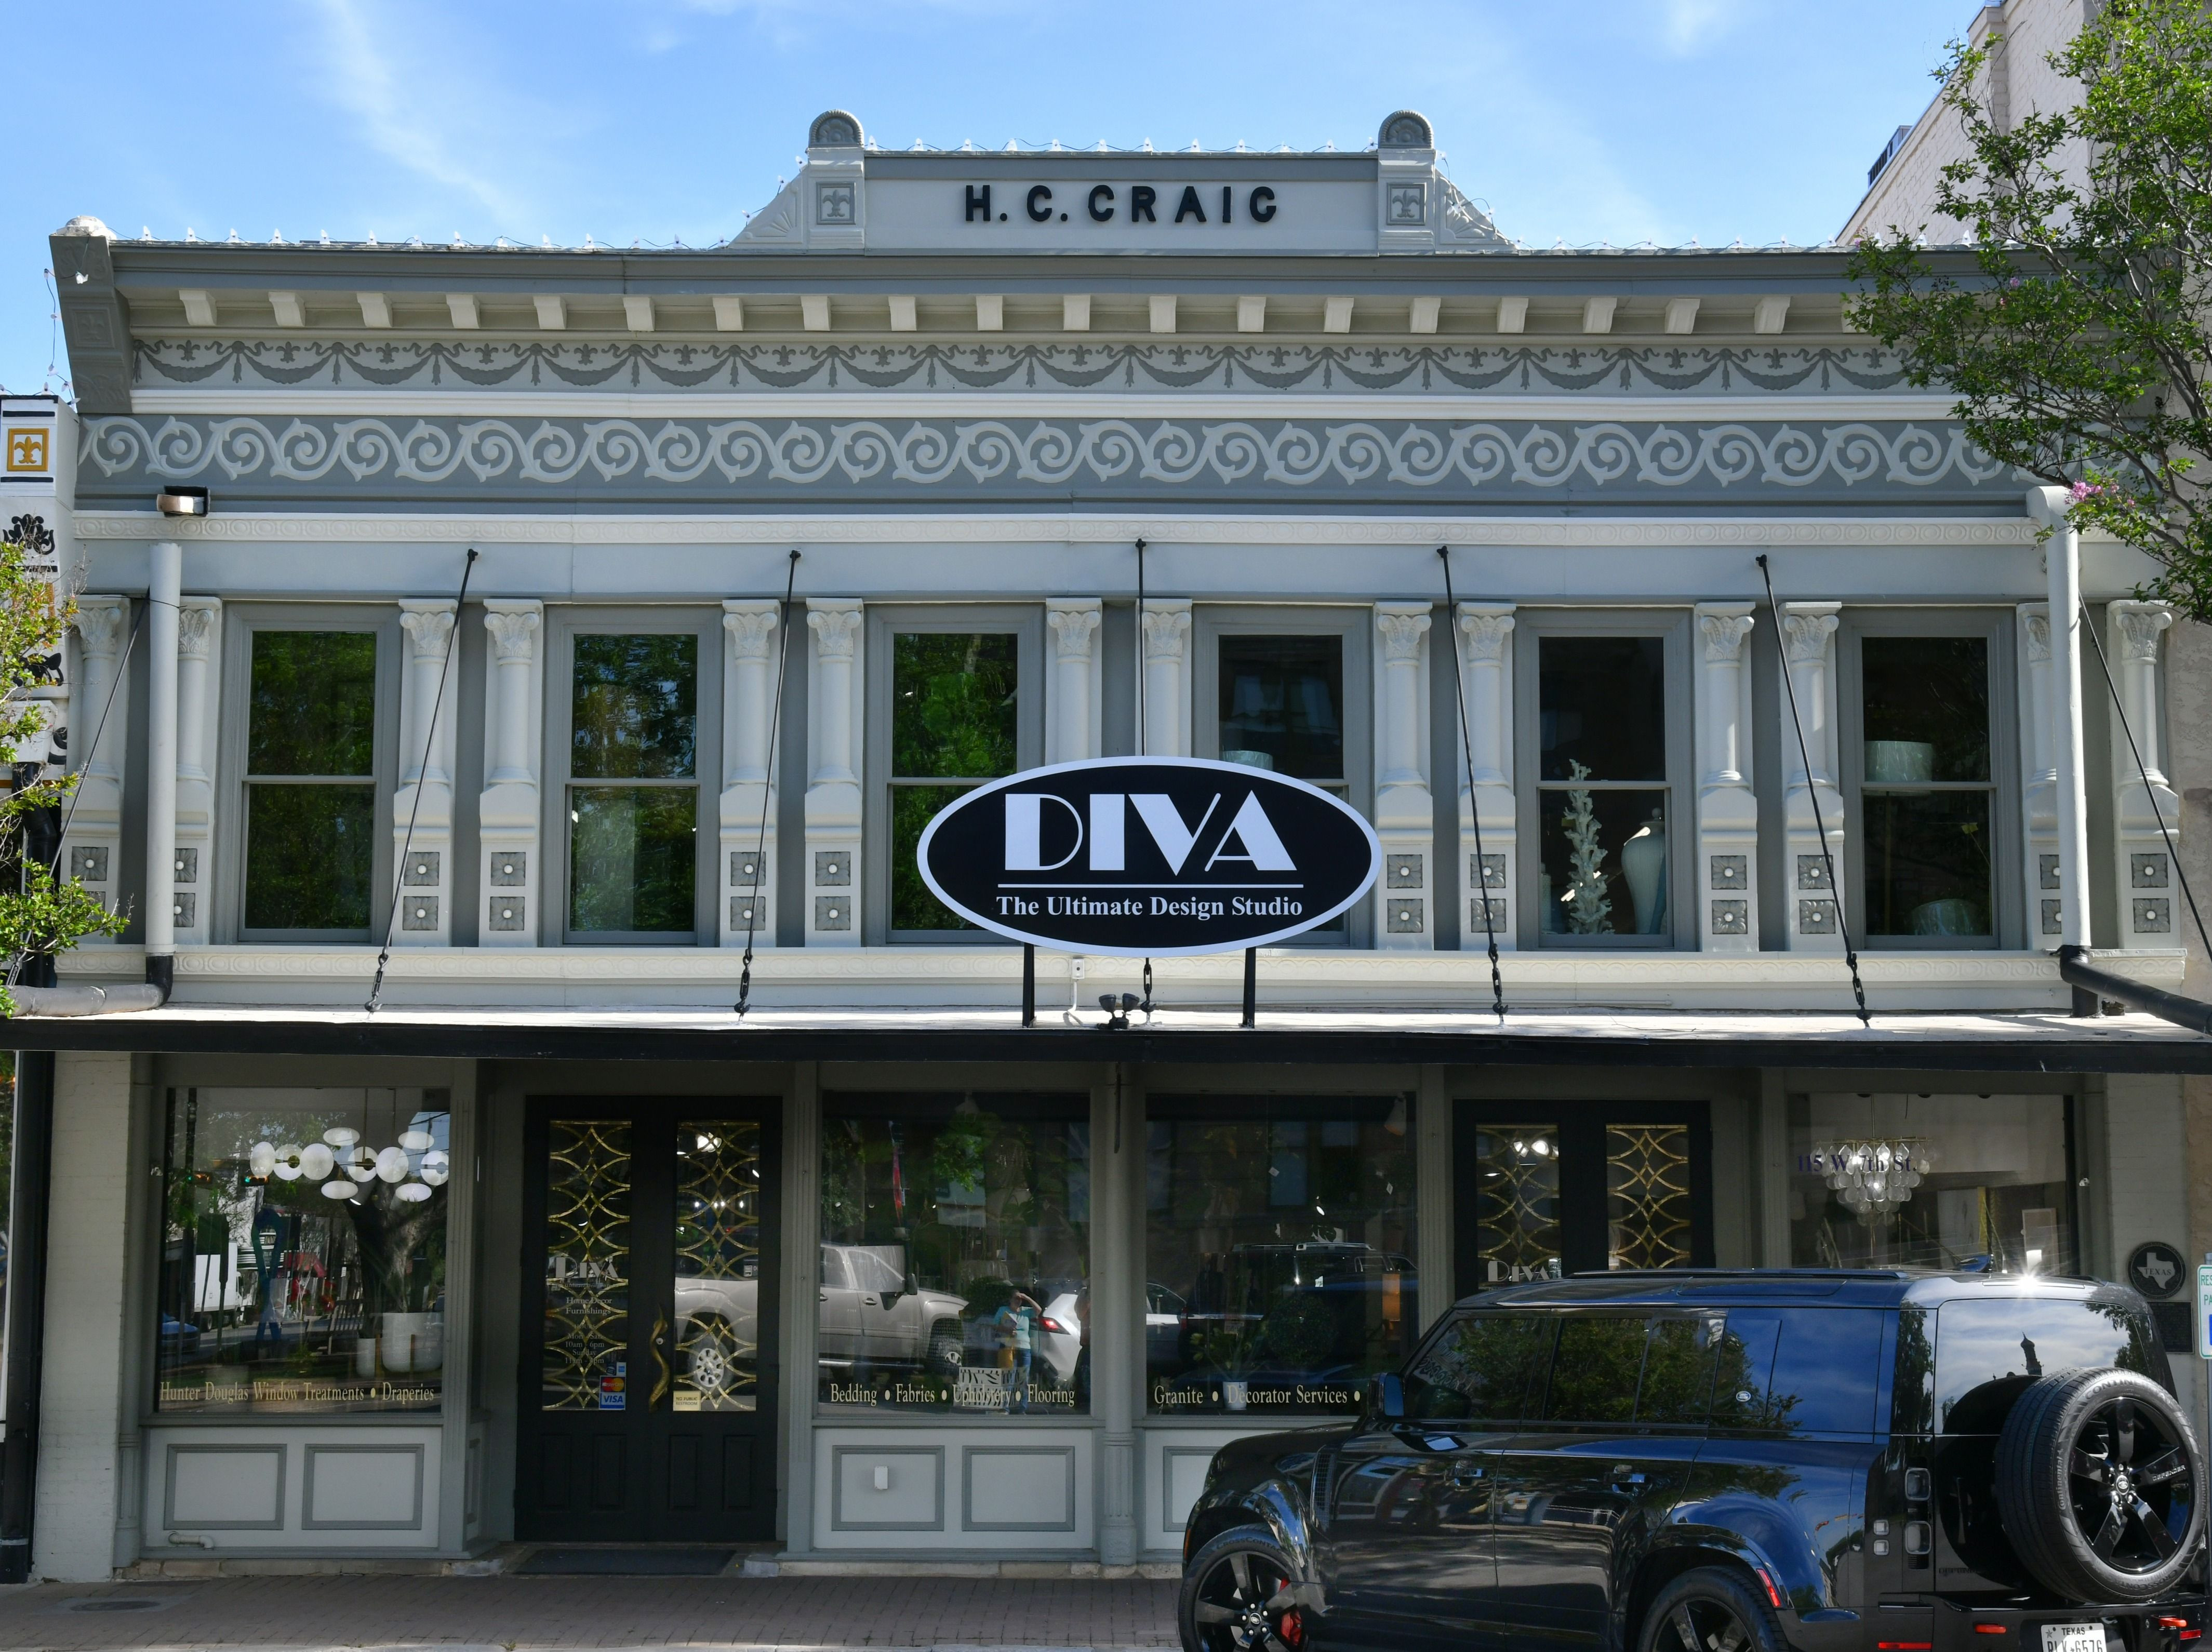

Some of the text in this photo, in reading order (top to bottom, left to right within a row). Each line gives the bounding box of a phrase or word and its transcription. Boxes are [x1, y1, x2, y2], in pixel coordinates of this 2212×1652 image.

[1088, 184, 1277, 223] CRAIG
[1005, 790, 1298, 876] DIVA
[996, 897, 1303, 921] The Ultimate Design Studio
[1797, 1154, 1823, 1172] 115
[1859, 1154, 1885, 1172] 7th
[1894, 1154, 1916, 1172] St.
[555, 1256, 619, 1280] DIVA
[1488, 1259, 1550, 1282] DIVA
[566, 1307, 611, 1316] Furnishings
[160, 1381, 434, 1405] Hunter Douglas Window Treatments Draperies
[830, 1383, 1075, 1407] Bedding Fabrics Upholstery Flooring
[1154, 1384, 1348, 1404] Granite Decorator Services
[2152, 1464, 2186, 1481] DEFENDER
[2061, 1627, 2085, 1635] TEXAS
